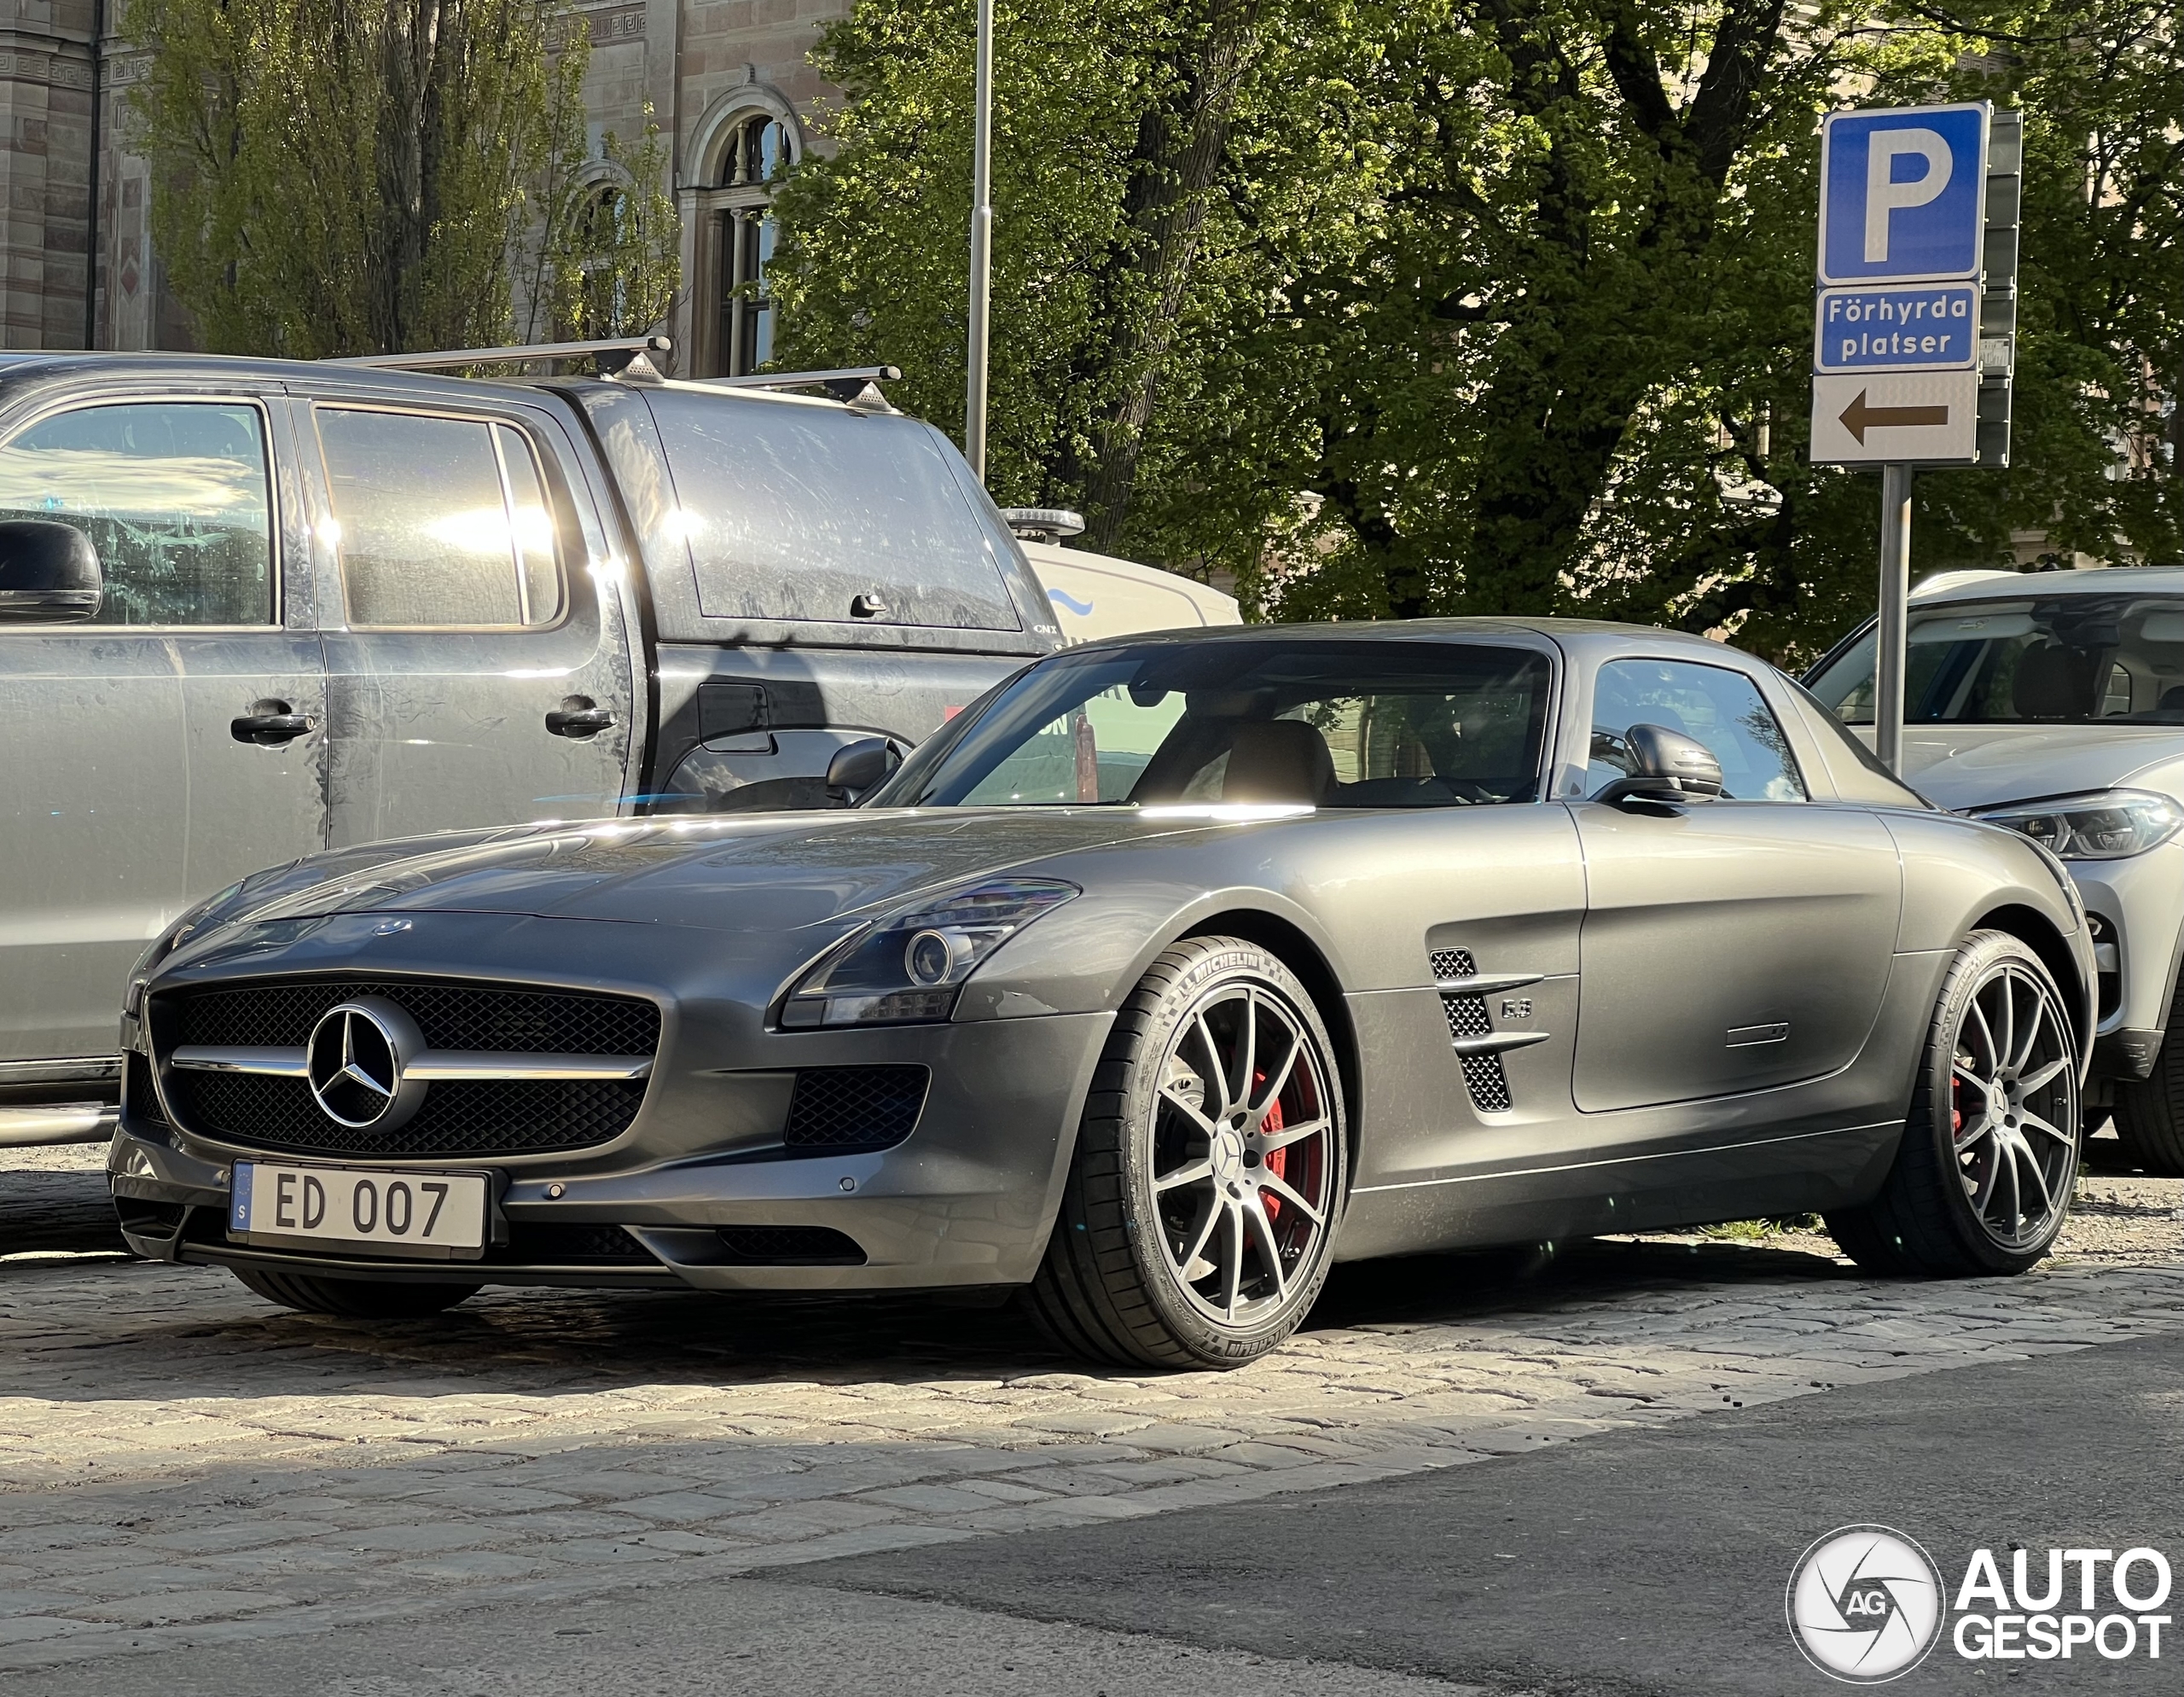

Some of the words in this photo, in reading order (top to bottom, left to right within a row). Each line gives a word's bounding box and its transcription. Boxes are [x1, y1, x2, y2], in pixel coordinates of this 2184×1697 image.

[1864, 127, 1954, 263] P
[1829, 294, 1966, 326] Förhyrda
[1842, 331, 1951, 362] platser
[1194, 952, 1259, 983] MICHELIN
[1502, 998, 1532, 1020] 6.3
[238, 1205, 246, 1219] S
[276, 1173, 326, 1229] ED
[352, 1179, 449, 1237] 007
